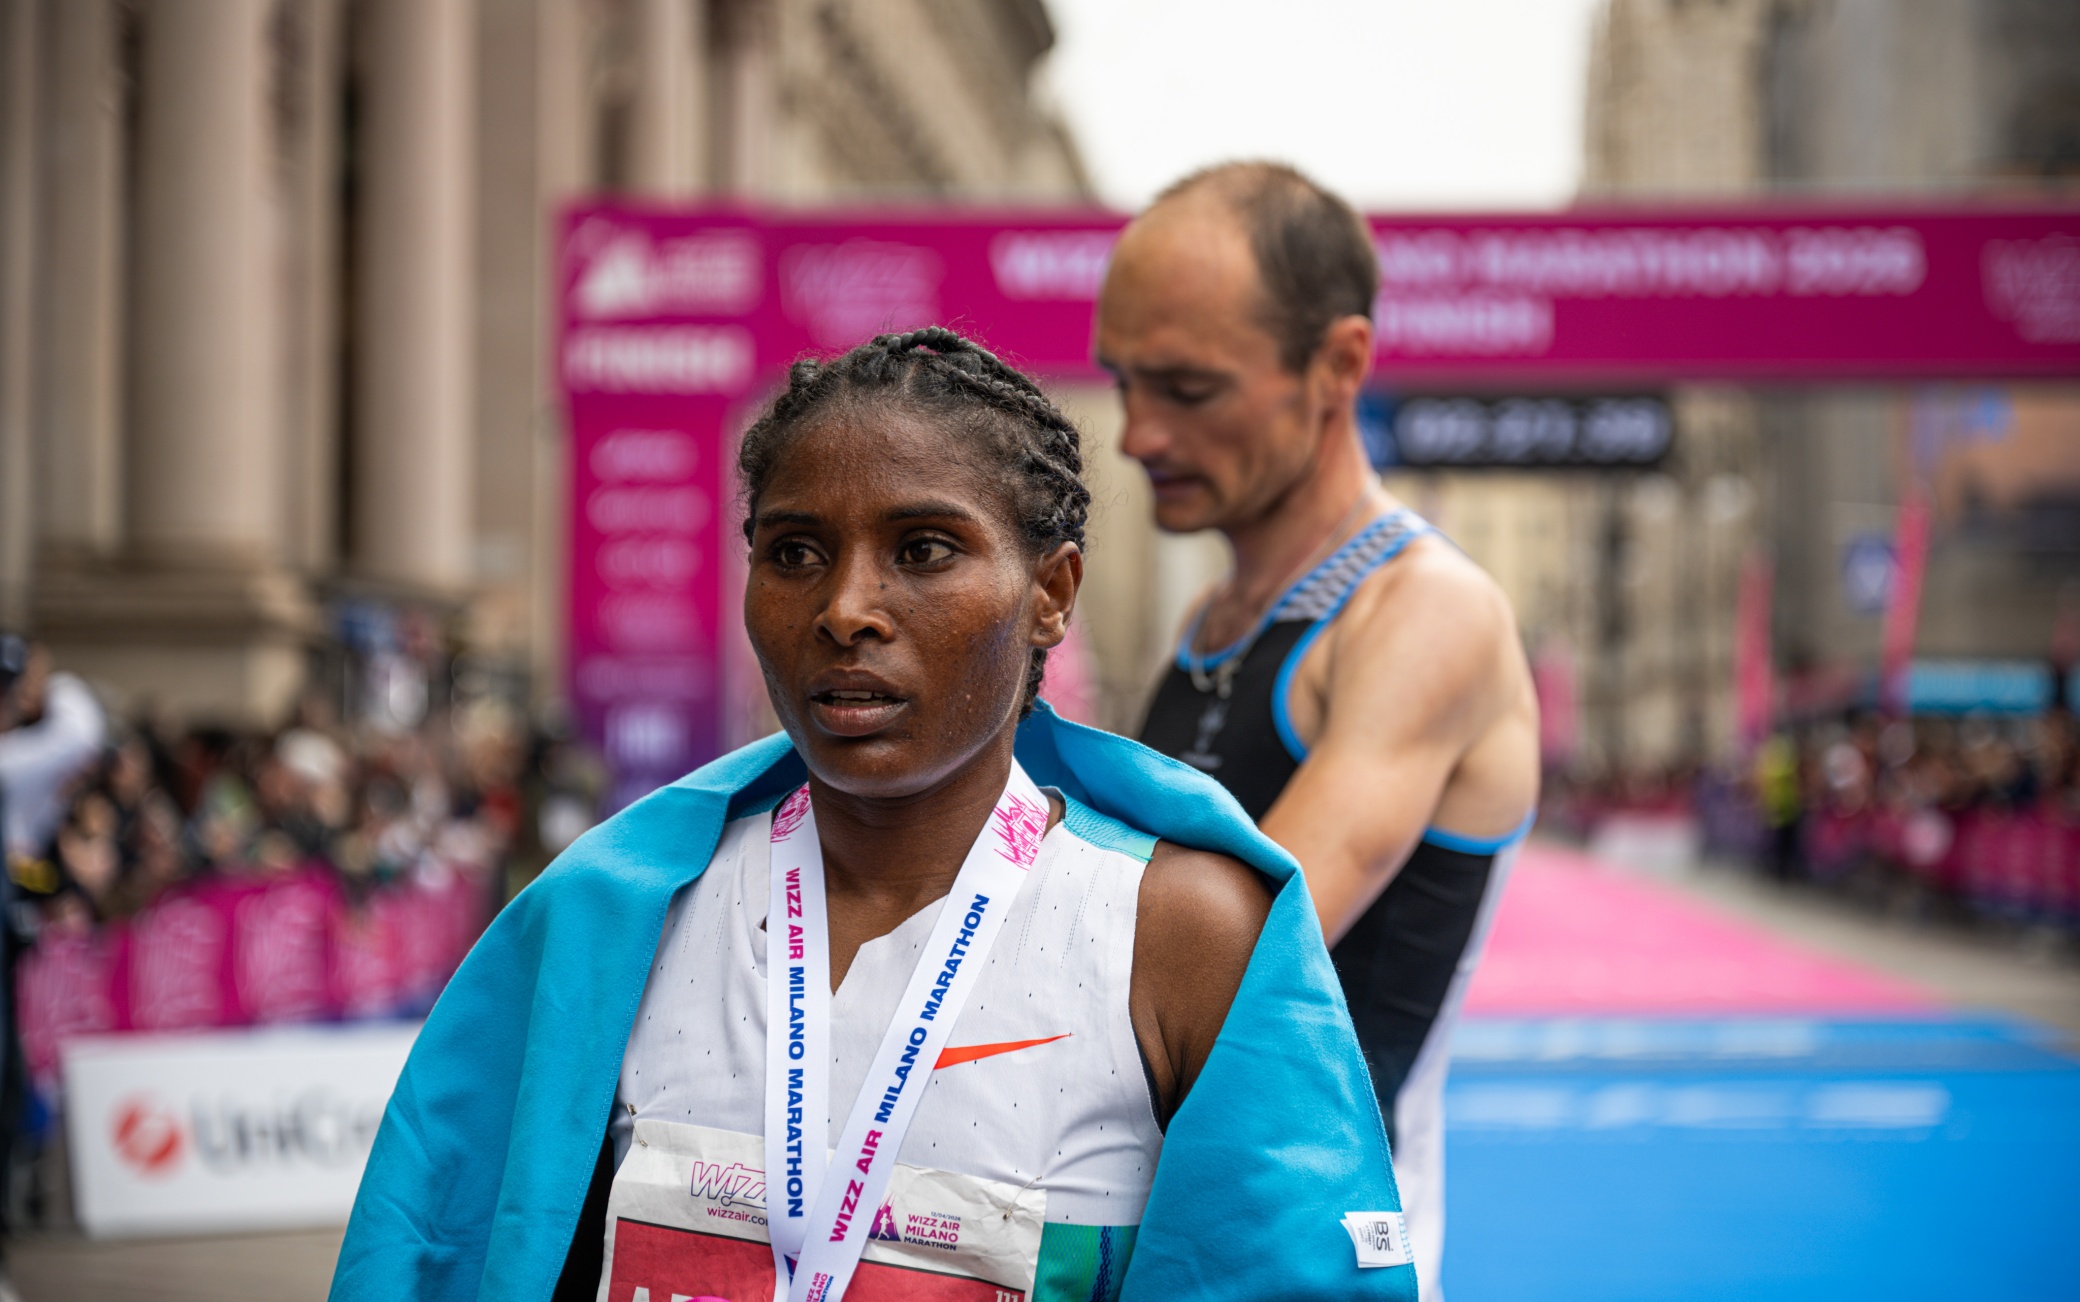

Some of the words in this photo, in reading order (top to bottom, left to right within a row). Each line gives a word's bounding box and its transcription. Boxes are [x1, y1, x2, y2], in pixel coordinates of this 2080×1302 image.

[786, 867, 802, 918] WIZZ
[788, 924, 804, 960] AIR
[789, 966, 804, 1060] MILANO
[829, 1179, 864, 1242] WIZZ
[856, 1129, 883, 1175] AIR
[874, 1026, 927, 1124] MILANO
[920, 893, 990, 1021] MARATHON
[787, 1068, 804, 1218] MARATHON
[904, 1236, 957, 1251] MARATHON
[905, 1224, 959, 1243] MILANO
[908, 1214, 938, 1227] WIZZ
[940, 1220, 960, 1231] AIR
